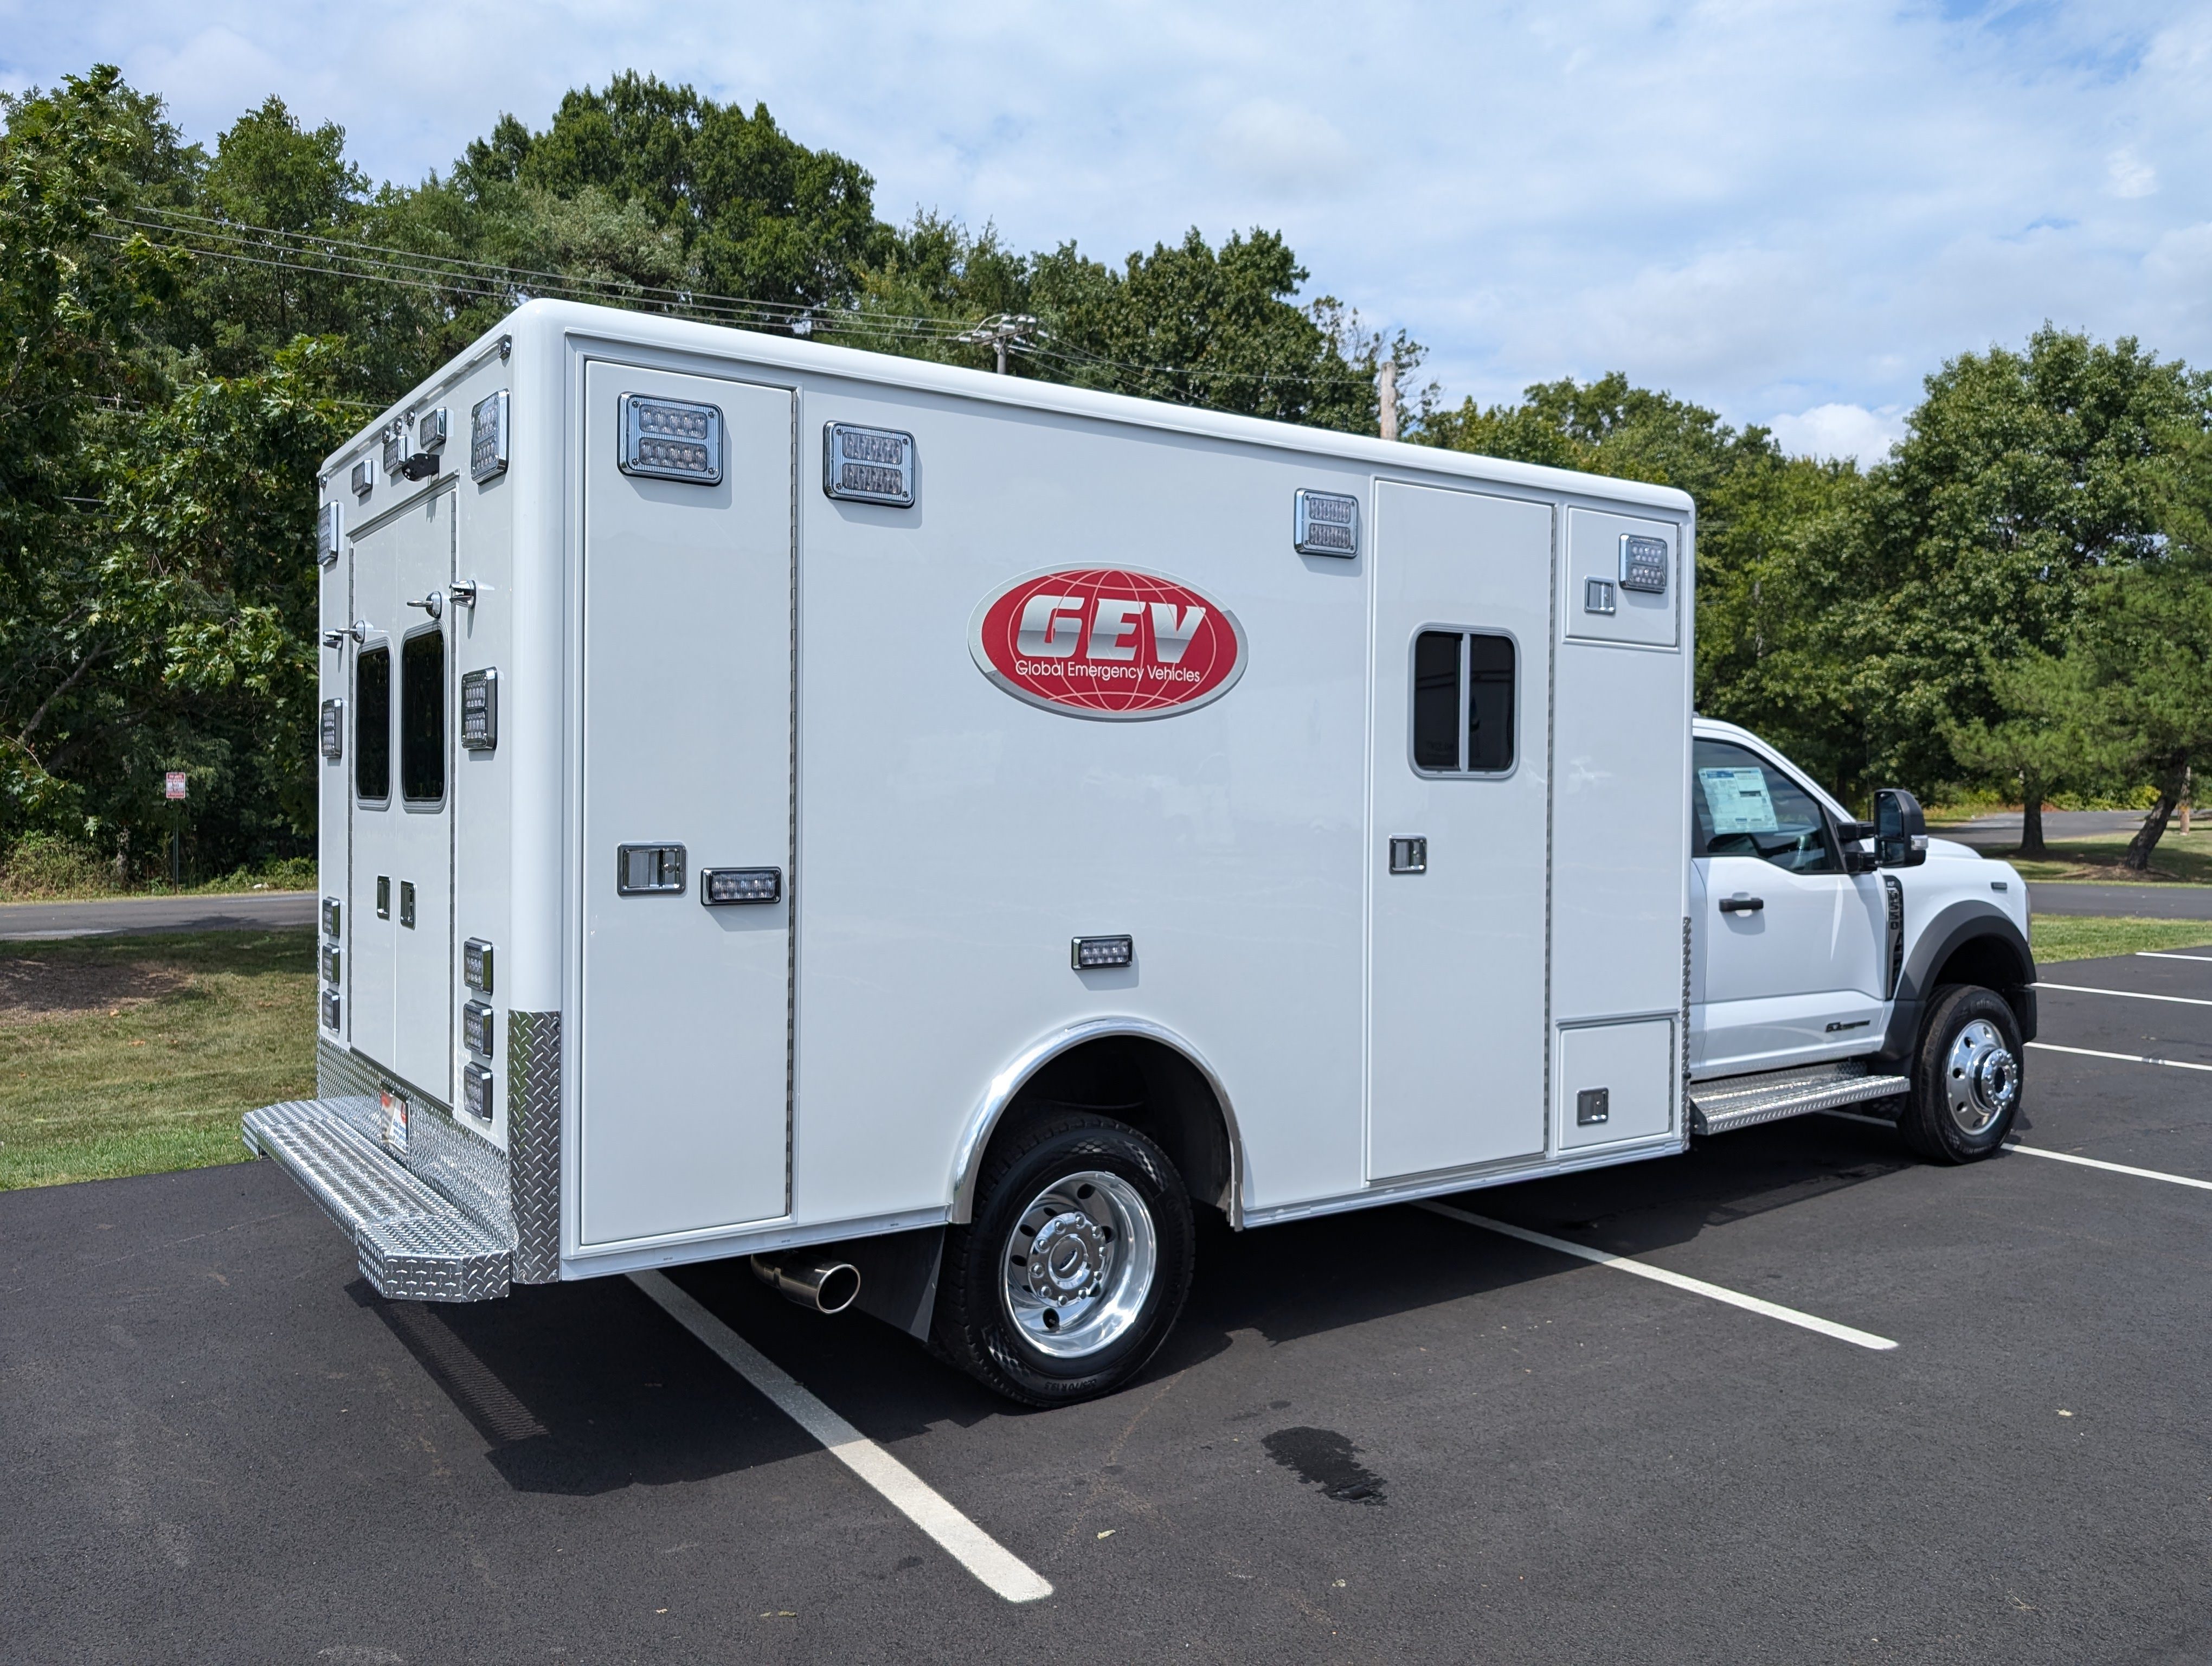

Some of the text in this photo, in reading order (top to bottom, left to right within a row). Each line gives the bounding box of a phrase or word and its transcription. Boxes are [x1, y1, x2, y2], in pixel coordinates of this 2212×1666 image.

[1017, 594, 1206, 663] GEV
[1015, 659, 1200, 683] Global Emergency Vehicles
